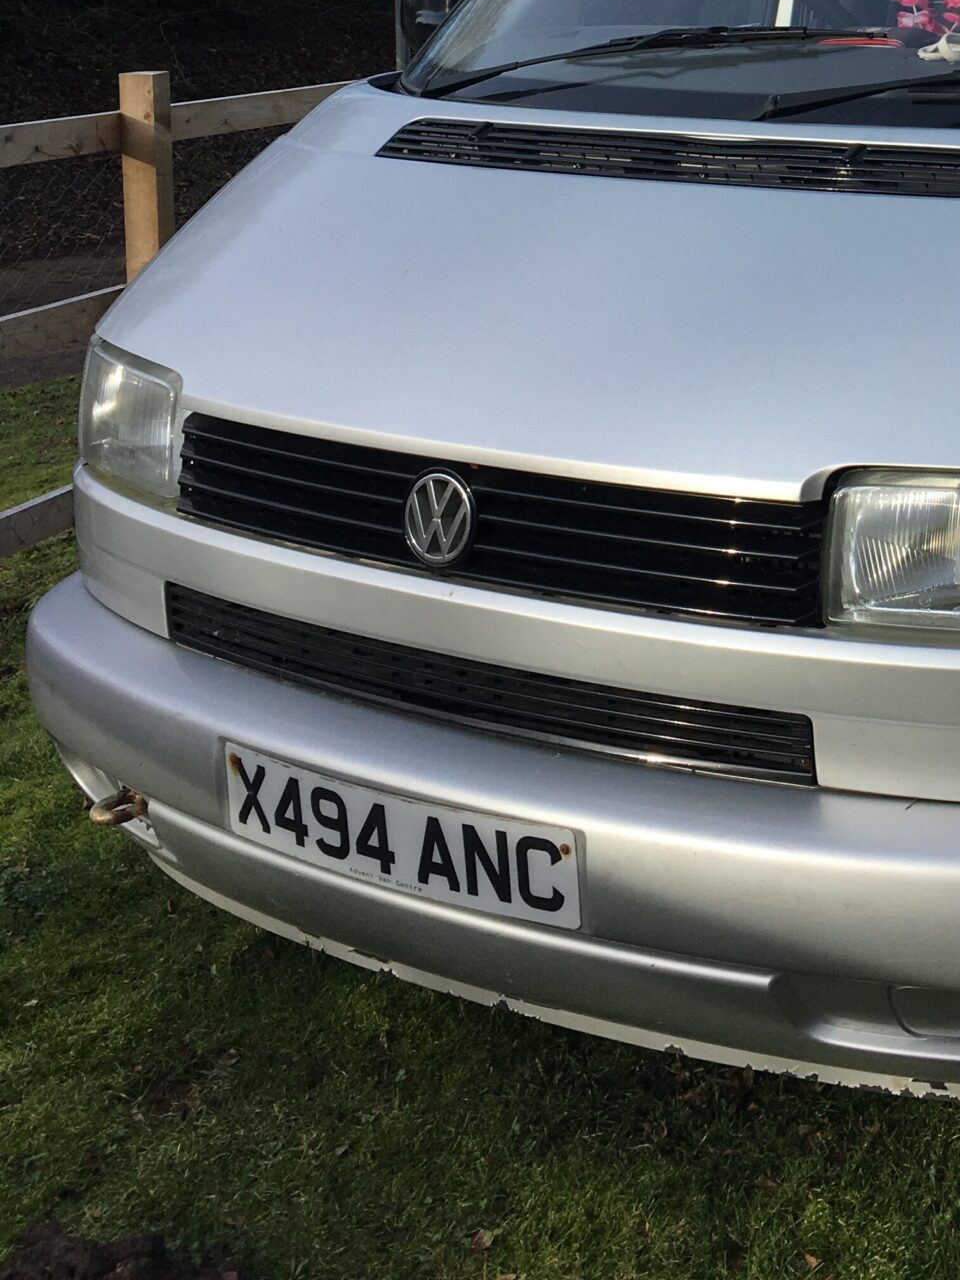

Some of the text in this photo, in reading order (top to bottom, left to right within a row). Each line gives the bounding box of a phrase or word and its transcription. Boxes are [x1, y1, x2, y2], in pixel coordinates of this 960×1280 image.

[405, 473, 471, 563] VW
[236, 756, 566, 913] X494 ANC
[395, 880, 423, 893] Centre
